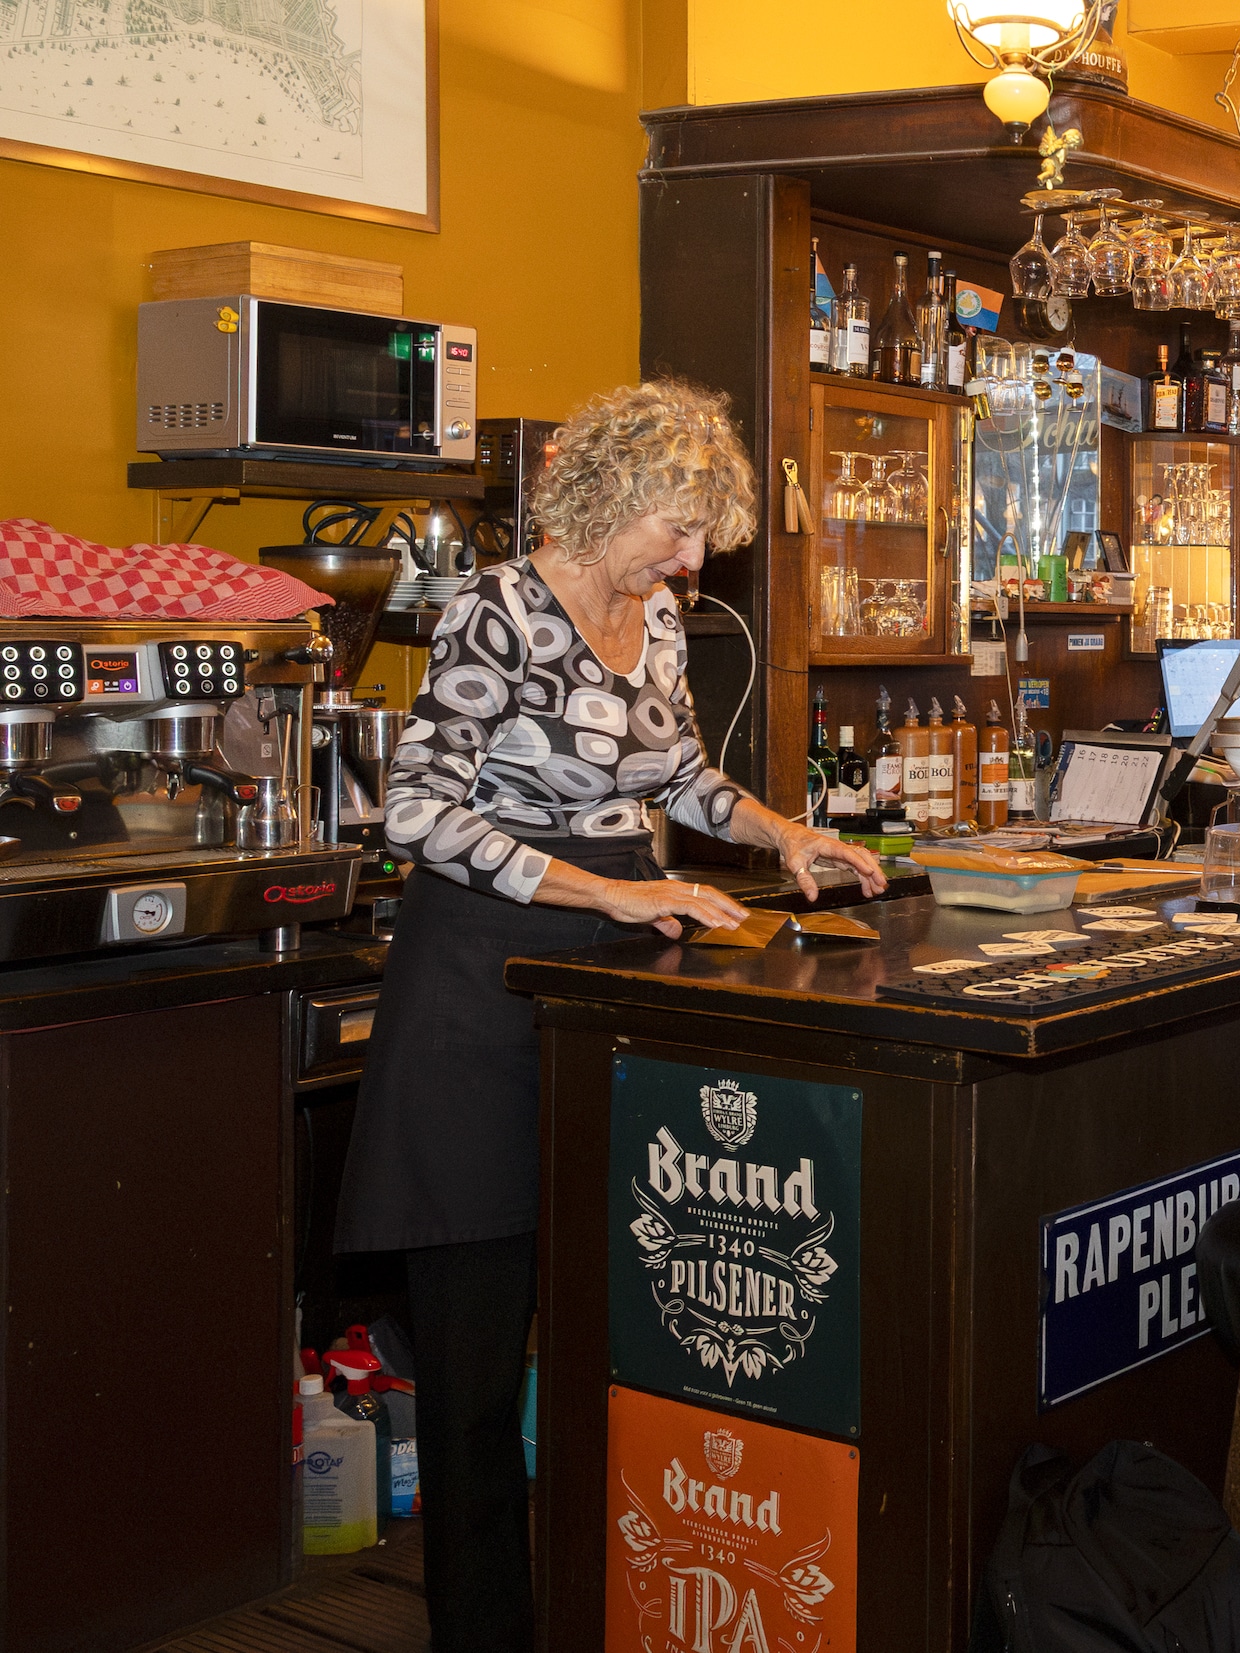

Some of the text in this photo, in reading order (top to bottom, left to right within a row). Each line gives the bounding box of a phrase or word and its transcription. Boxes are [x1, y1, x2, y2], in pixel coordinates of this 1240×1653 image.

[1077, 749, 1086, 760] 16
[1089, 751, 1097, 761] 17
[1100, 753, 1109, 763] 18
[1111, 754, 1119, 764] 19
[1121, 755, 1130, 767] 20
[1131, 757, 1140, 767] 21
[1141, 756, 1150, 768] 22
[909, 770, 929, 780] BOL
[931, 767, 953, 777] BOL
[713, 1113, 744, 1126] WYLRE
[648, 1125, 821, 1223] Brand
[708, 1233, 756, 1259] 1340
[669, 1259, 798, 1321] PILSENER
[662, 1457, 782, 1537] Brand
[700, 1543, 736, 1564] 1340
[662, 1556, 770, 1653] IPA
